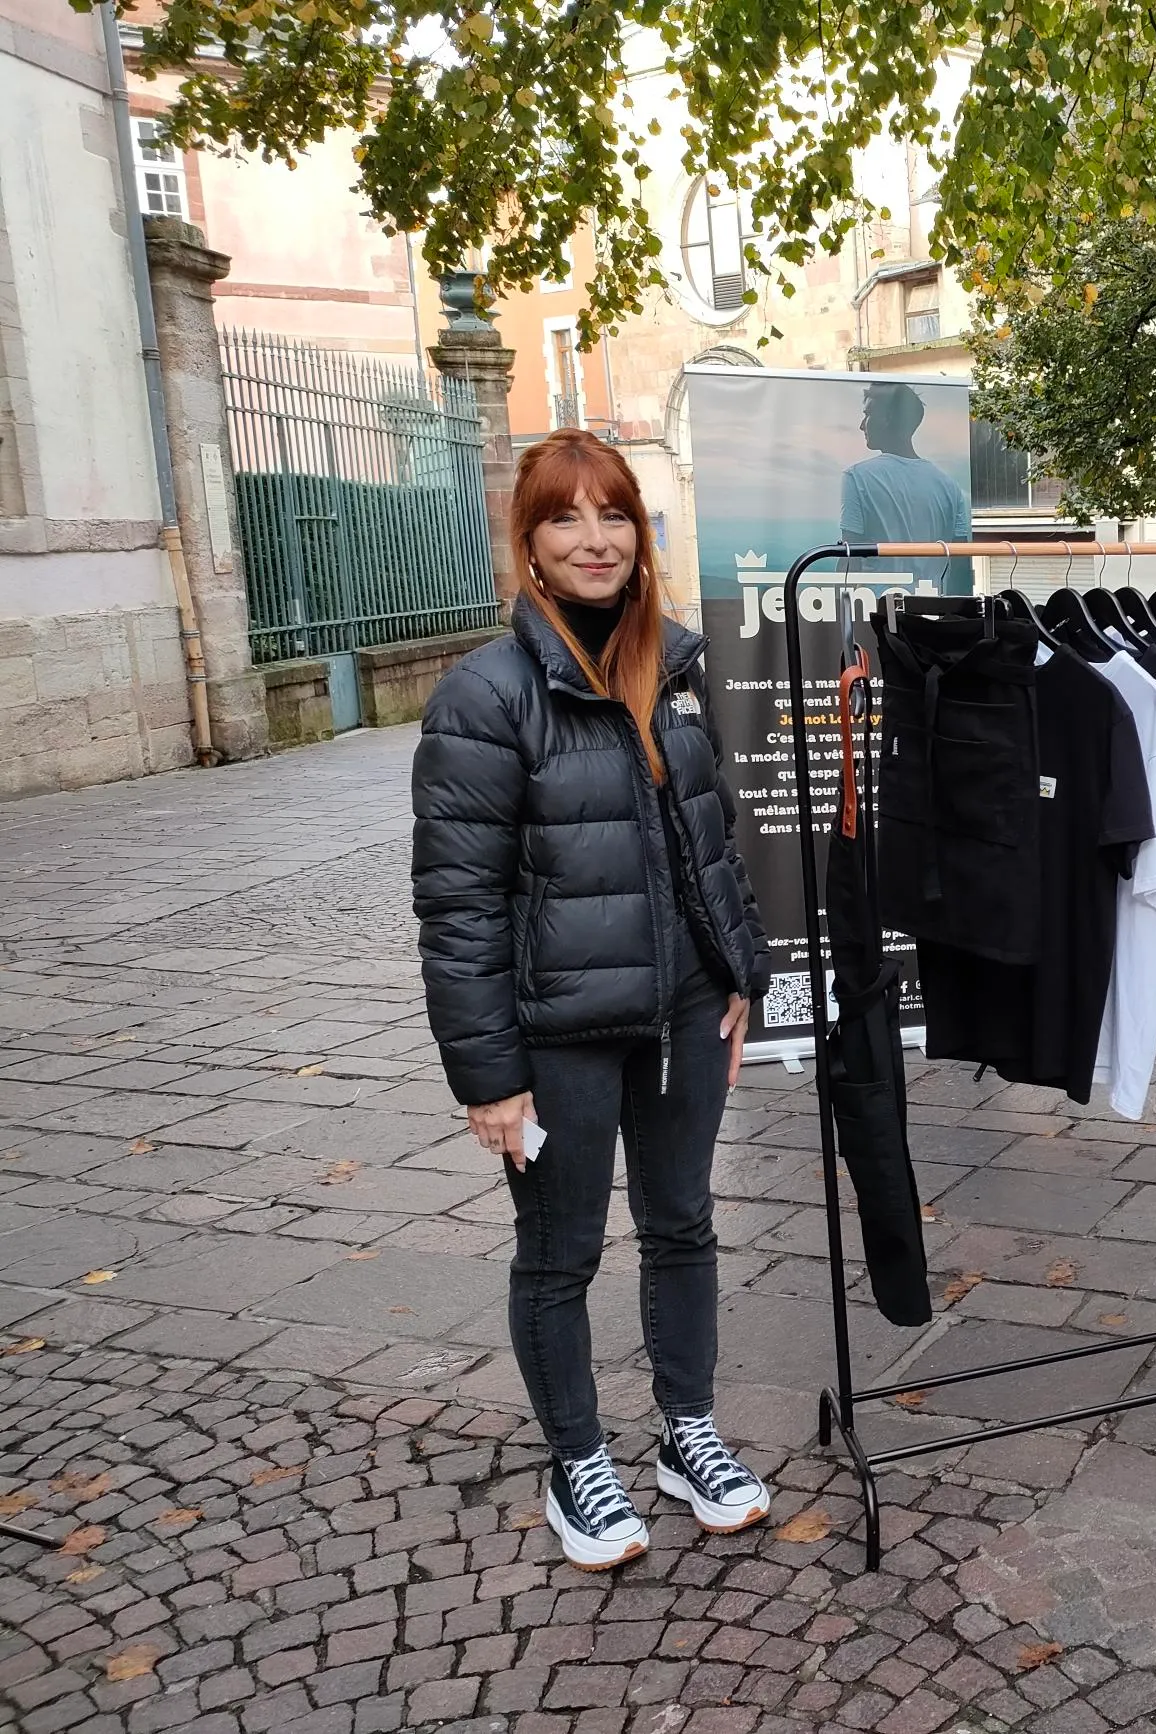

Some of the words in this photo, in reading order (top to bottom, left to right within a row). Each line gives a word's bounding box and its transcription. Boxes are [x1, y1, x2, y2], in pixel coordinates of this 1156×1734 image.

[725, 679, 773, 690] Jeanot
[780, 714, 826, 725] Jenot
[734, 752, 748, 763] la
[751, 750, 789, 763] mode
[808, 749, 821, 761] le
[738, 788, 768, 799] tout
[771, 788, 788, 798] en
[760, 823, 793, 834] dans
